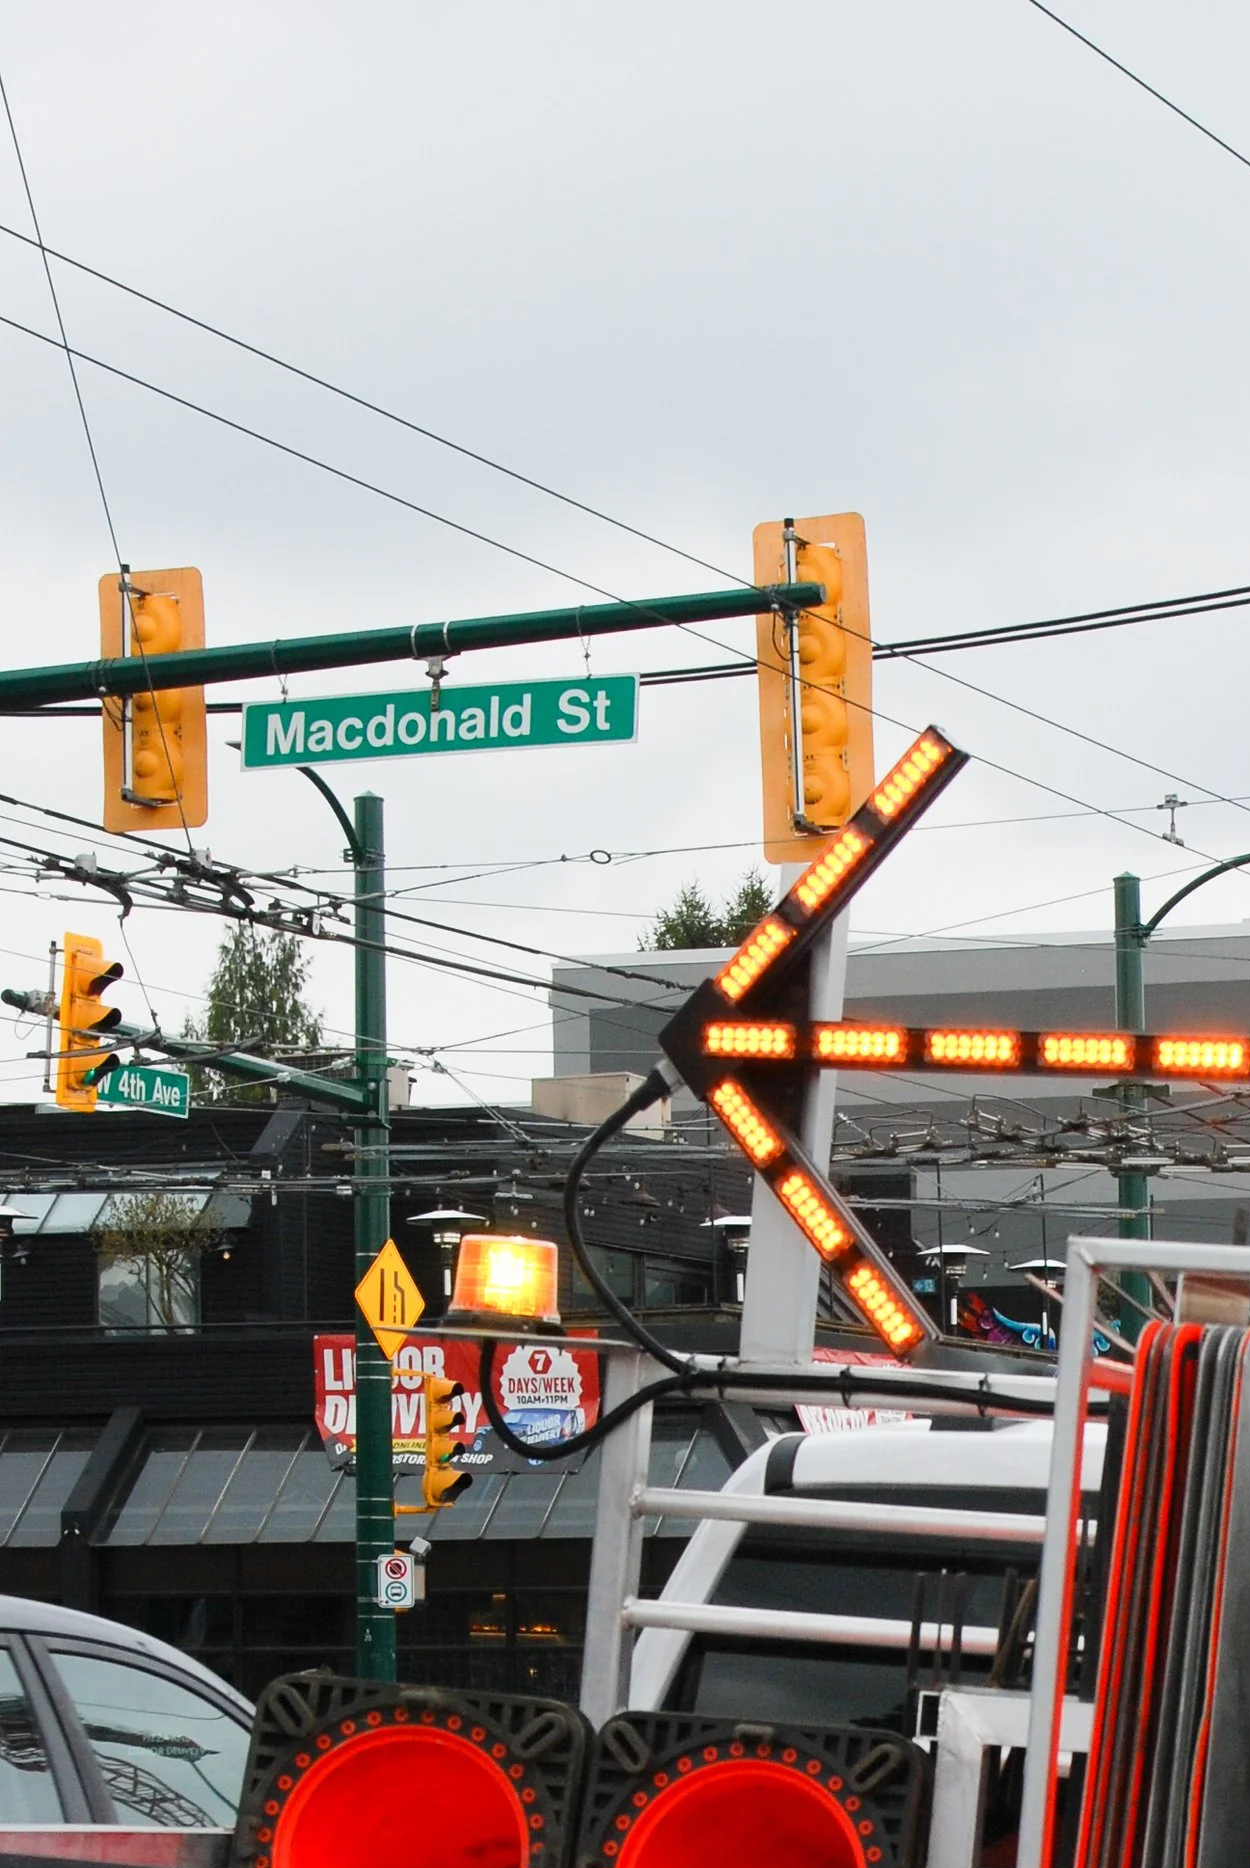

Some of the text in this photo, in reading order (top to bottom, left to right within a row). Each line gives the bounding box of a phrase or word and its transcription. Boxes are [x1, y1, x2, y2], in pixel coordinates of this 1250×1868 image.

[266, 688, 611, 756] Macdonald St
[97, 1070, 181, 1107] W 4th Ave
[324, 1346, 446, 1390] LIOR
[534, 1353, 547, 1371] 7
[508, 1376, 576, 1394] DAYS/WEEK
[460, 1452, 494, 1465] SHOP
